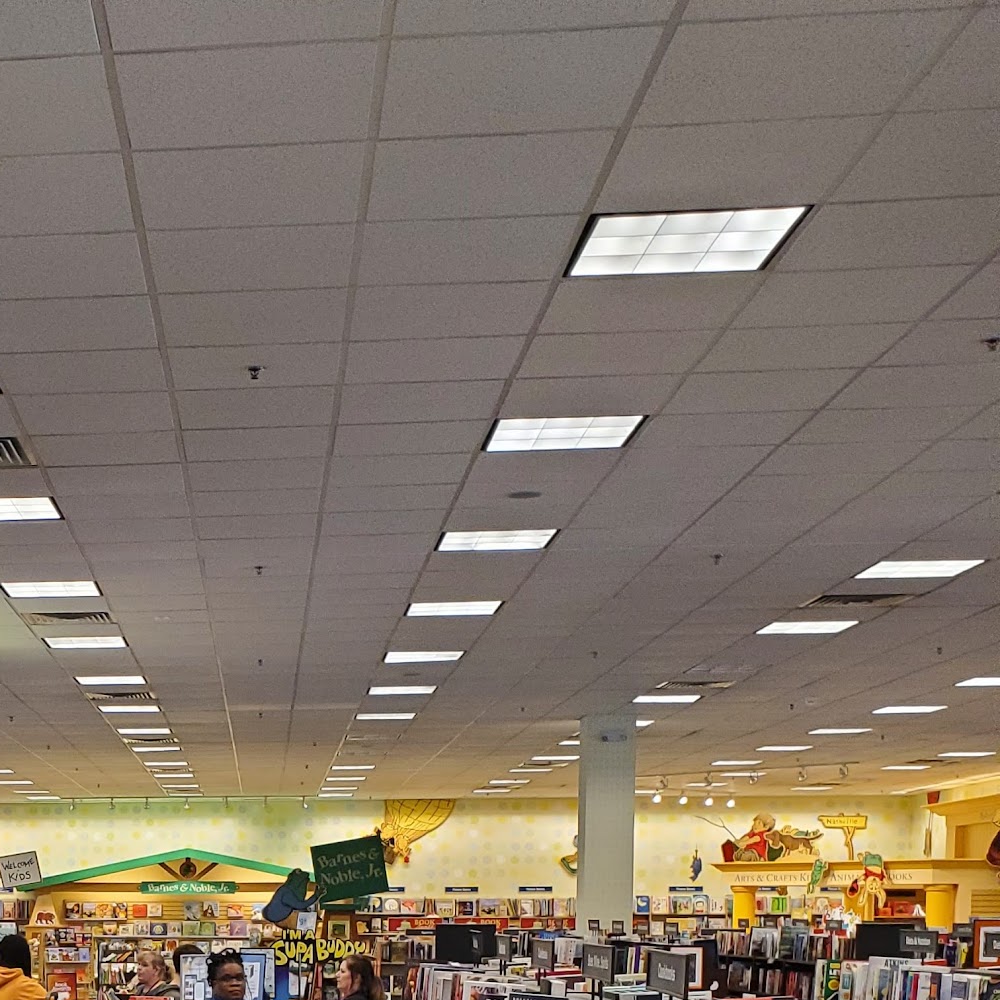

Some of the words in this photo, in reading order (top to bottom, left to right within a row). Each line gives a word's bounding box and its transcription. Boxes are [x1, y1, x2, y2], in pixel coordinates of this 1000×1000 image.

[1, 858, 35, 871] WELCOME
[317, 850, 367, 868] Barnes
[367, 848, 379, 860] &
[8, 871, 32, 882] KIDS
[366, 863, 383, 879] Jr.
[147, 883, 178, 892] Barnes
[180, 883, 188, 892] &
[282, 929, 302, 940] I'M
[304, 930, 315, 939] A
[270, 940, 314, 966] SUPA
